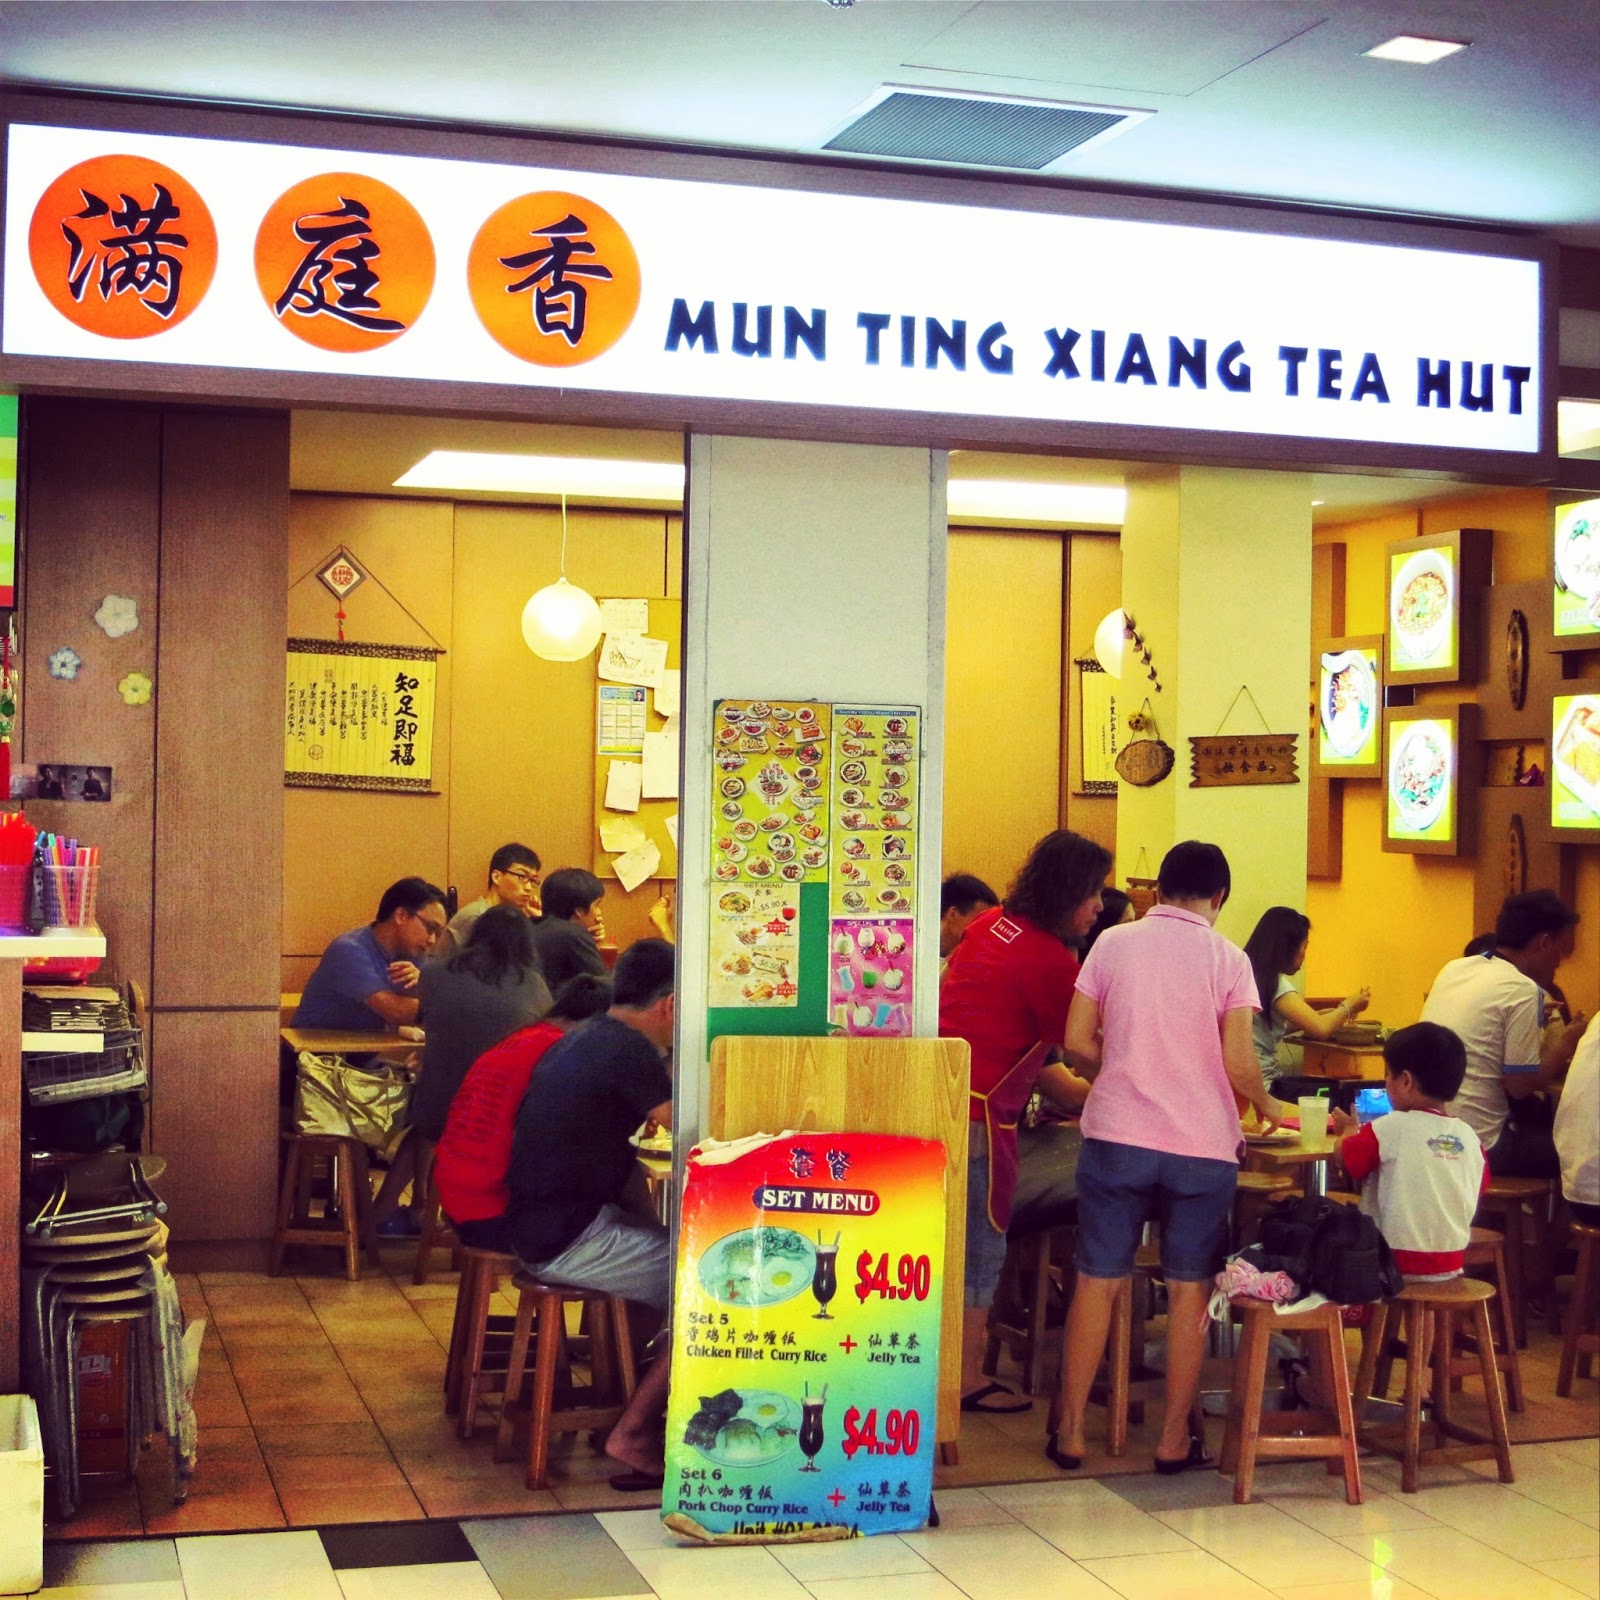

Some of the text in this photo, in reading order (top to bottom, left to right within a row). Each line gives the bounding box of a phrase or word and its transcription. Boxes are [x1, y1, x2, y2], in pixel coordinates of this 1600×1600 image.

[664, 298, 1531, 414] MUN TING XIANG TEA HUT
[390, 671, 420, 767] 知足即福
[789, 1147, 853, 1182] 套餐
[762, 1189, 875, 1212] SET MENU
[855, 1249, 931, 1304] $4.90
[688, 1311, 729, 1325] Set 5
[867, 1331, 921, 1350] 仙草茶
[686, 1344, 828, 1364] Chicken Fillet Curry Rice
[867, 1352, 920, 1365] Jelly Tea
[842, 1405, 920, 1460] $4.90
[681, 1467, 722, 1480] Set 6
[857, 1480, 912, 1498] 仙草茶
[679, 1500, 808, 1516] Pork Chop Curry Rice
[856, 1500, 911, 1514] Jelly Tea
[733, 1520, 765, 1535] Unit
